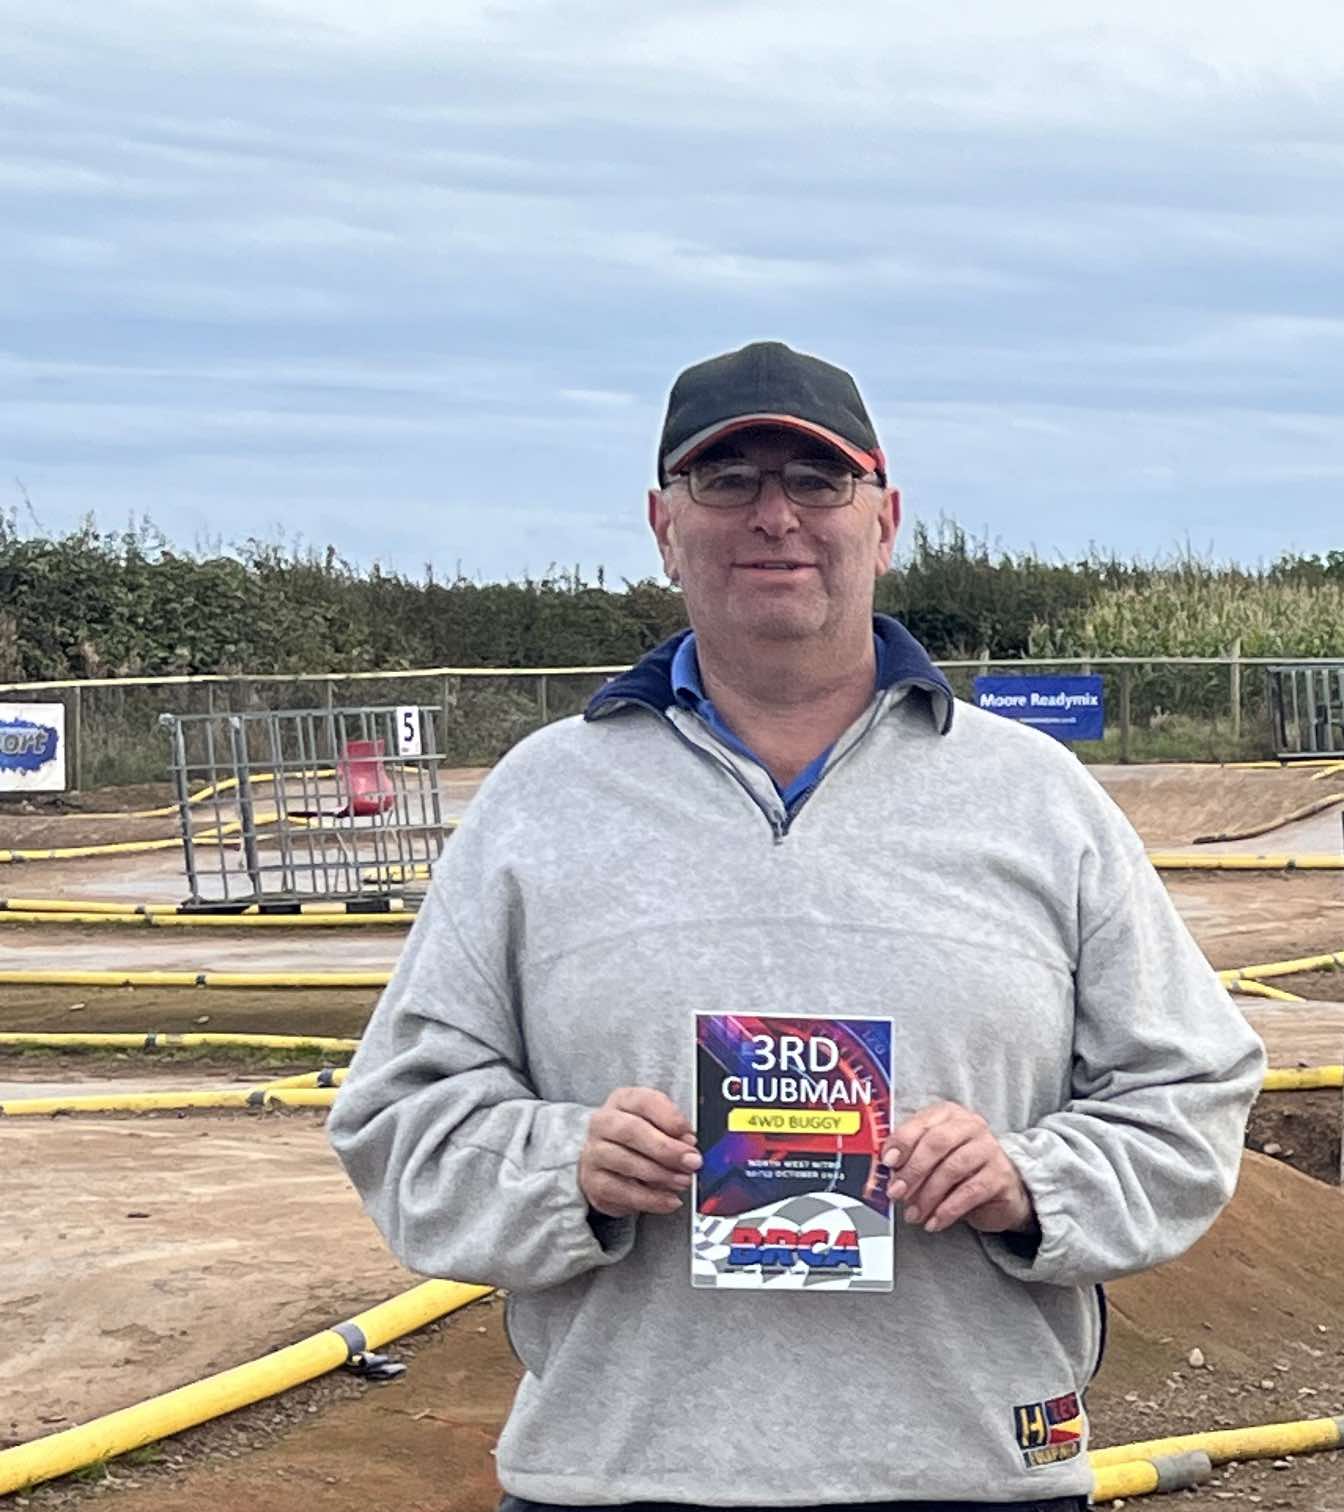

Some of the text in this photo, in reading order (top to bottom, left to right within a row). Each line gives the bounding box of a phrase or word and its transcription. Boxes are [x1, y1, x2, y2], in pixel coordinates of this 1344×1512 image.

[0, 730, 48, 754] ort
[404, 712, 414, 742] 5
[750, 1034, 839, 1073] 3RD
[721, 1075, 872, 1105] CLUBMAN
[747, 1114, 842, 1130] 4WD BUGGY
[728, 1227, 861, 1268] BRCA
